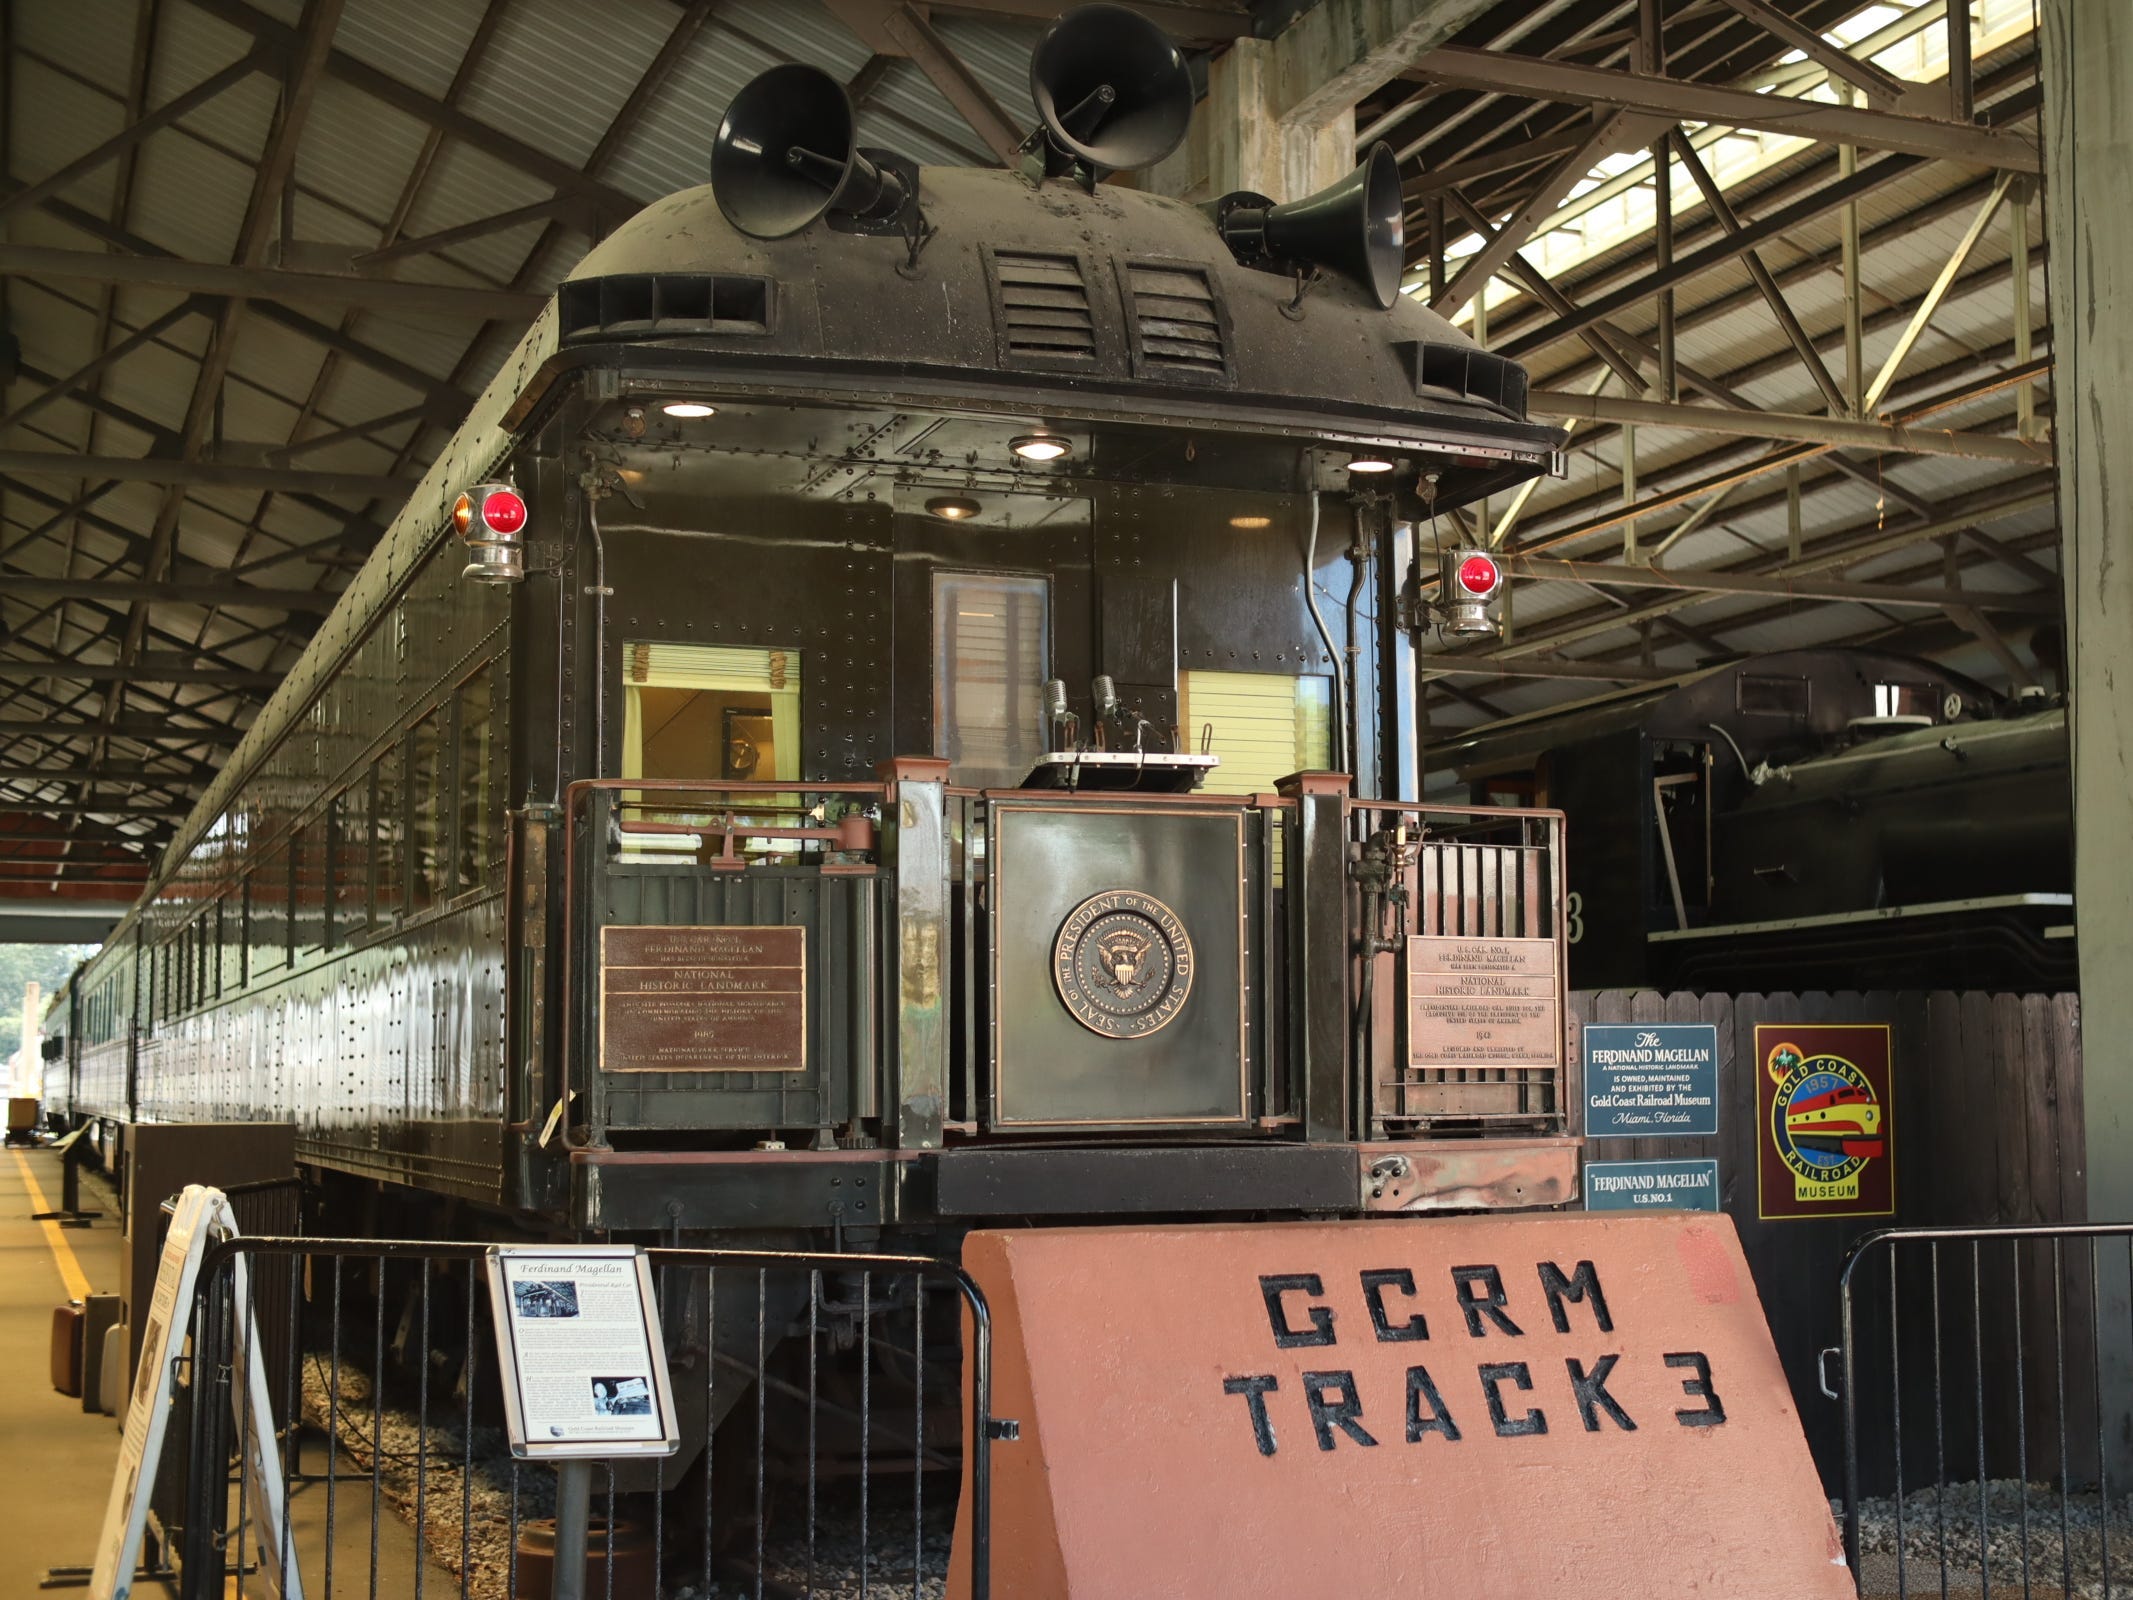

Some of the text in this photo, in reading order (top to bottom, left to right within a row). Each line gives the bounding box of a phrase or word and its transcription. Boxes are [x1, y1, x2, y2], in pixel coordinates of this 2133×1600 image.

[645, 945, 763, 953] FERDINAND MAGELLAN
[1060, 896, 1188, 1030] SEAL OF THE PRESIDENT OF THE UNITED STATES
[1439, 954, 1526, 963] FERDINAND MAGELLAN
[674, 971, 734, 979] NATIONAL
[1461, 977, 1505, 985] NATIONAL
[640, 981, 768, 990] HISTORIC LANDMARK
[1436, 986, 1529, 995] HISTORIC LANDMARK
[1634, 1032, 1662, 1048] The
[1592, 1049, 1709, 1064] FERDINAND MAGELLAN
[1622, 1075, 1647, 1083] OWNED,
[1777, 1060, 1865, 1107] GOLD COAST
[1805, 1076, 1839, 1094] 1957
[1591, 1093, 1711, 1107] Gold Coast Railroad Museum
[1654, 1111, 1691, 1123] Florida
[1786, 1150, 1860, 1181] RAILROAD
[1798, 1185, 1856, 1198] MUSEUM
[520, 1264, 622, 1276] Ferdinand Magellan
[1259, 1259, 1614, 1349] GCRM
[1222, 1351, 1727, 1457] TRACK 3
